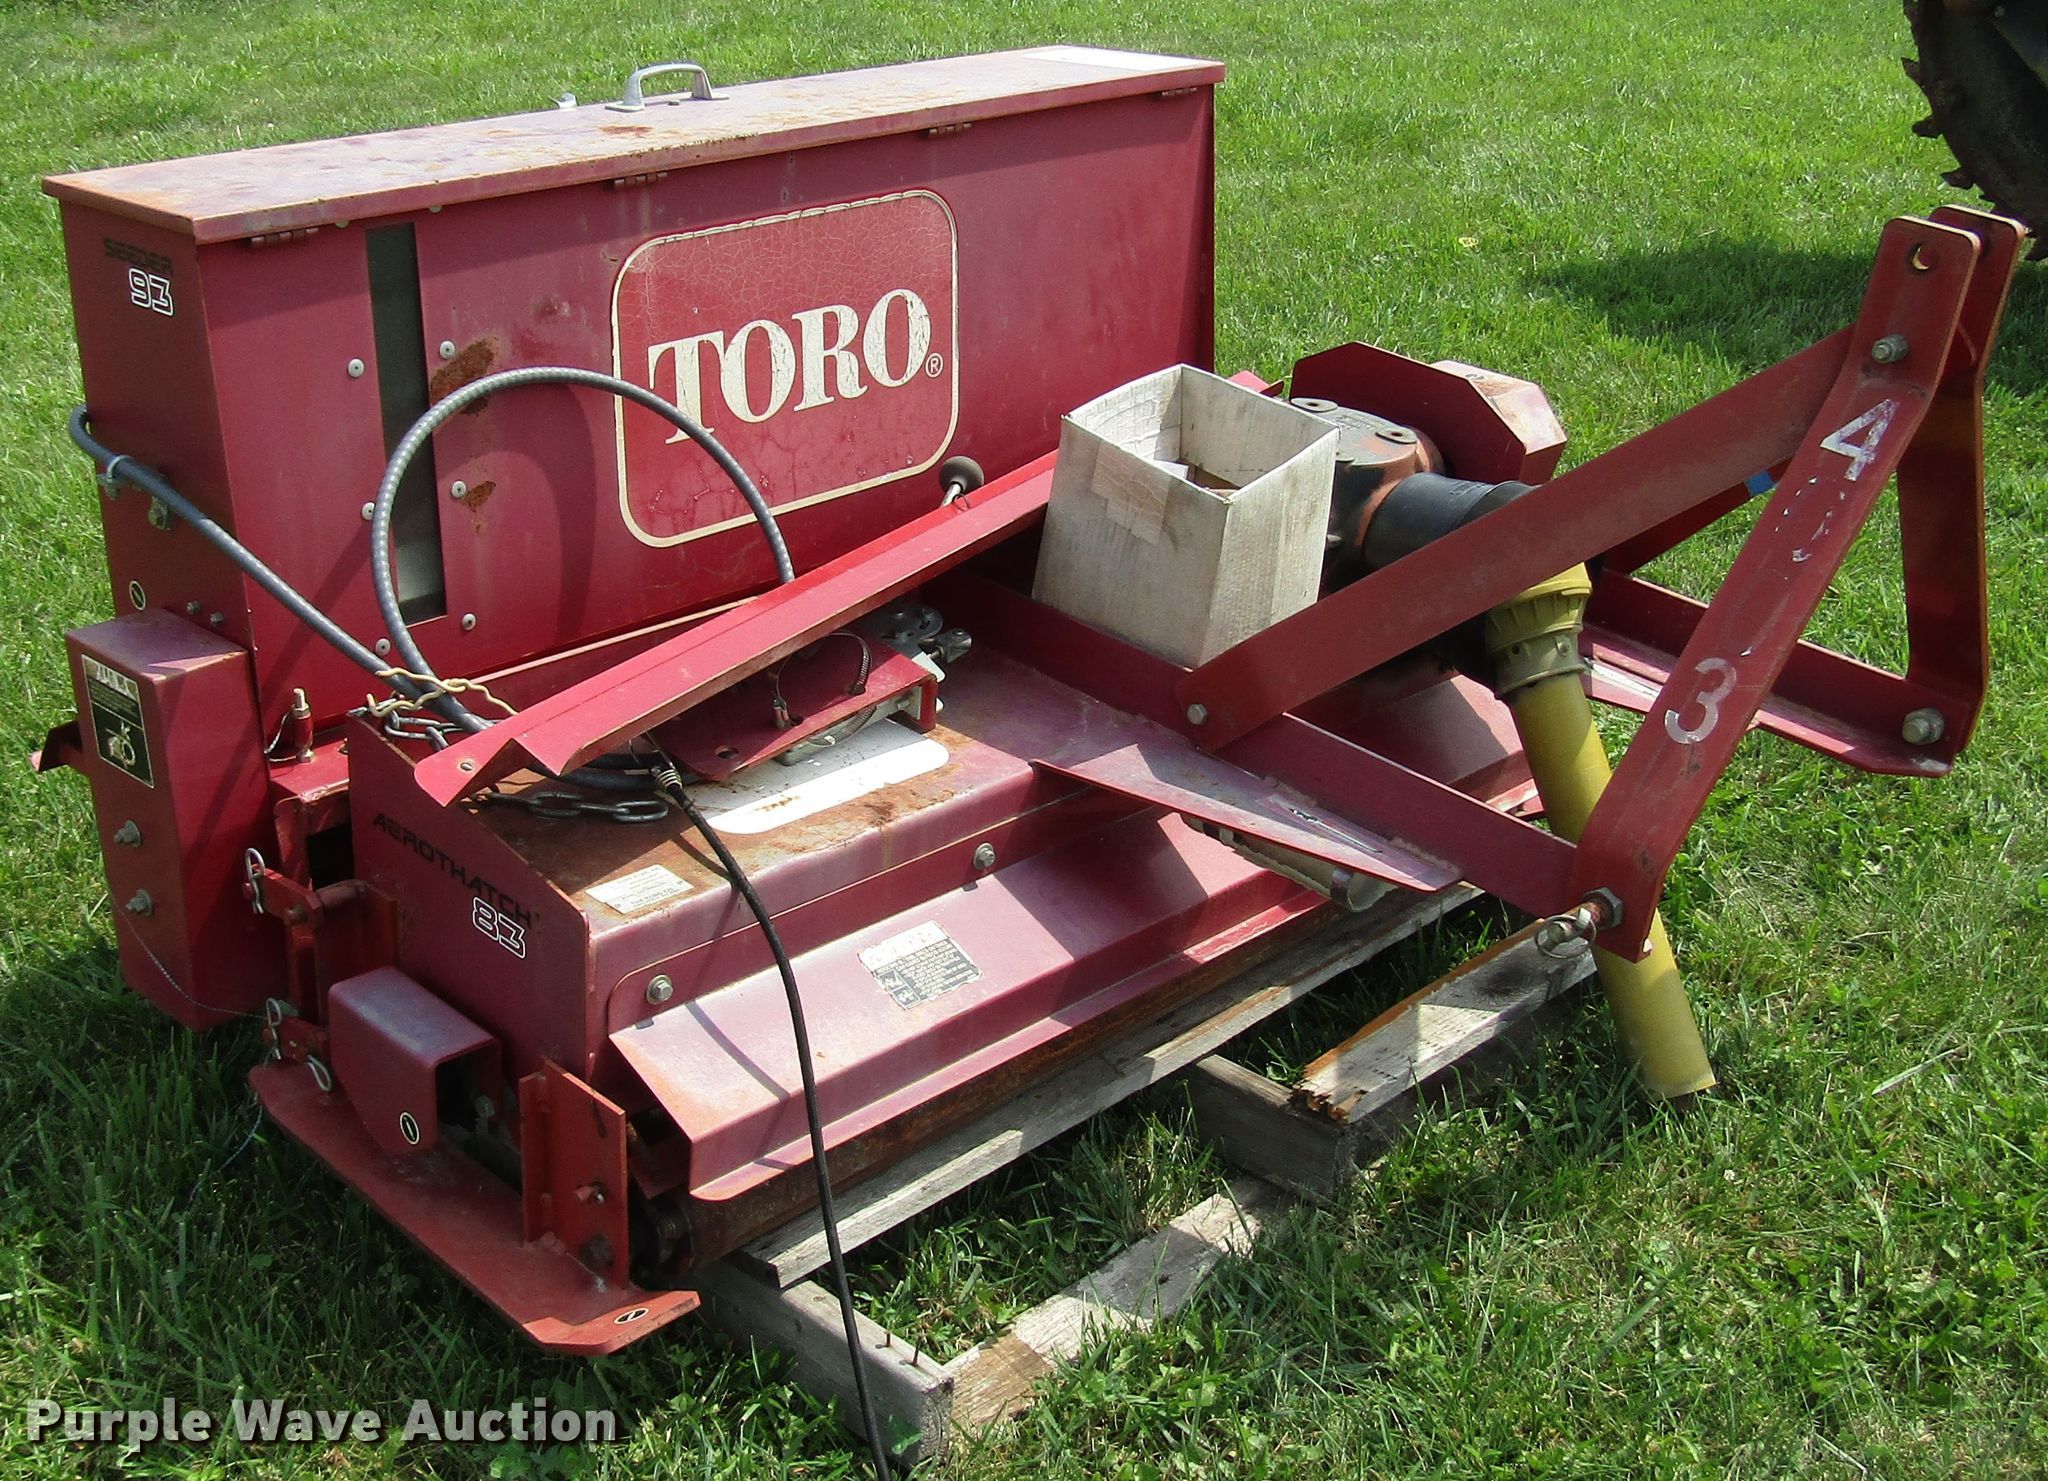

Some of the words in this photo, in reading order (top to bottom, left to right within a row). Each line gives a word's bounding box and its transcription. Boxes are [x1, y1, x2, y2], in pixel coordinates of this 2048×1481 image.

[128, 267, 174, 316] 93
[648, 288, 931, 444] TORO
[1820, 399, 1900, 481] 4
[1665, 657, 1737, 744] 3
[373, 812, 533, 929] AEROTHATCH
[472, 896, 526, 959] 83
